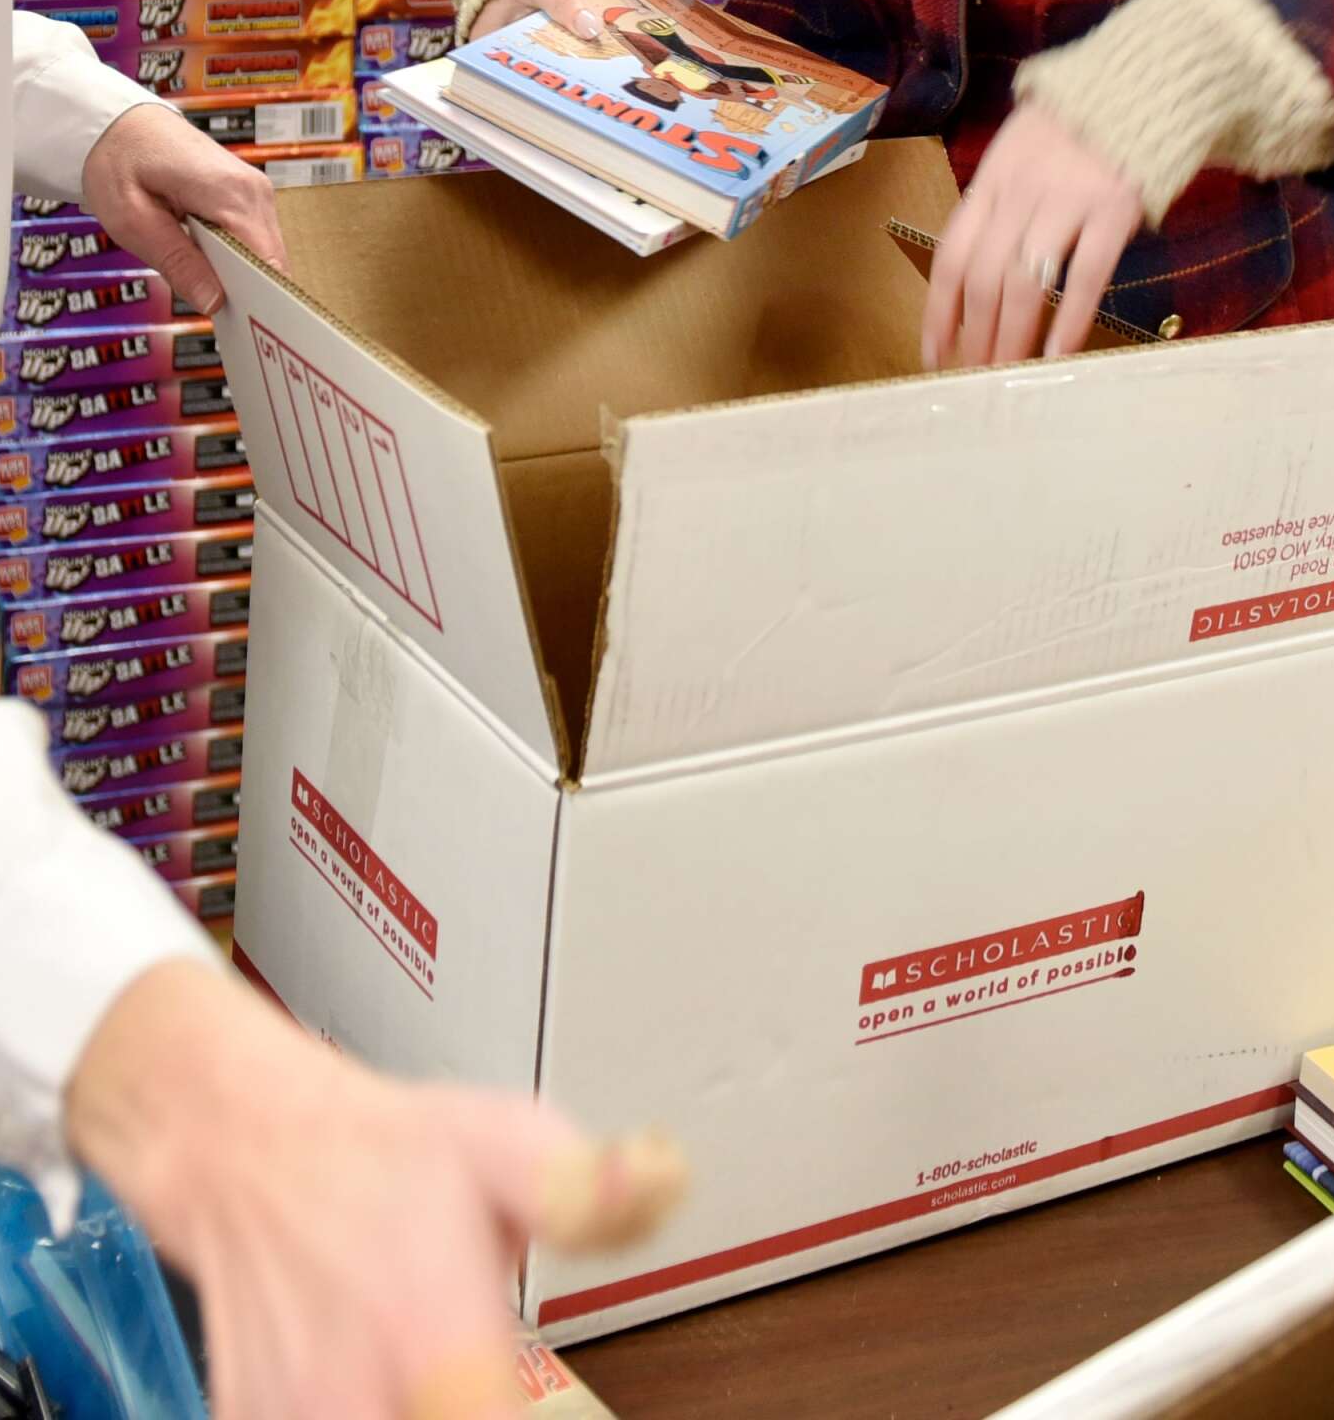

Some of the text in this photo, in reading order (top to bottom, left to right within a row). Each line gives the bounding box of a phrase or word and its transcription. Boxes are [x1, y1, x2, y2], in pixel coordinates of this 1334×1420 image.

[68, 280, 147, 312] BATTLE
[70, 335, 148, 369] BATTLE
[80, 384, 156, 417] BATTLE
[94, 437, 170, 472] BATTLE
[92, 492, 170, 525] BATTLE
[95, 543, 170, 577] BATTLE
[1233, 549, 1277, 571] 65101
[1280, 540, 1311, 561] MO
[1291, 558, 1329, 581] Road
[110, 594, 186, 630] BATTLE
[115, 645, 191, 681] BATTLE
[110, 692, 186, 727] BATTLE
[109, 742, 184, 777] BATTLE
[291, 816, 317, 855] open
[320, 849, 328, 864] a
[331, 860, 364, 905] world
[367, 902, 379, 923] of
[312, 798, 433, 945] SCHOLASTIC
[858, 1004, 914, 1030] open
[923, 999, 936, 1014] a
[946, 977, 1009, 1007] world
[1017, 966, 1039, 989] of
[916, 1140, 1037, 1187] 1-800-scholastic
[931, 1172, 1017, 1208] scholastic.com
